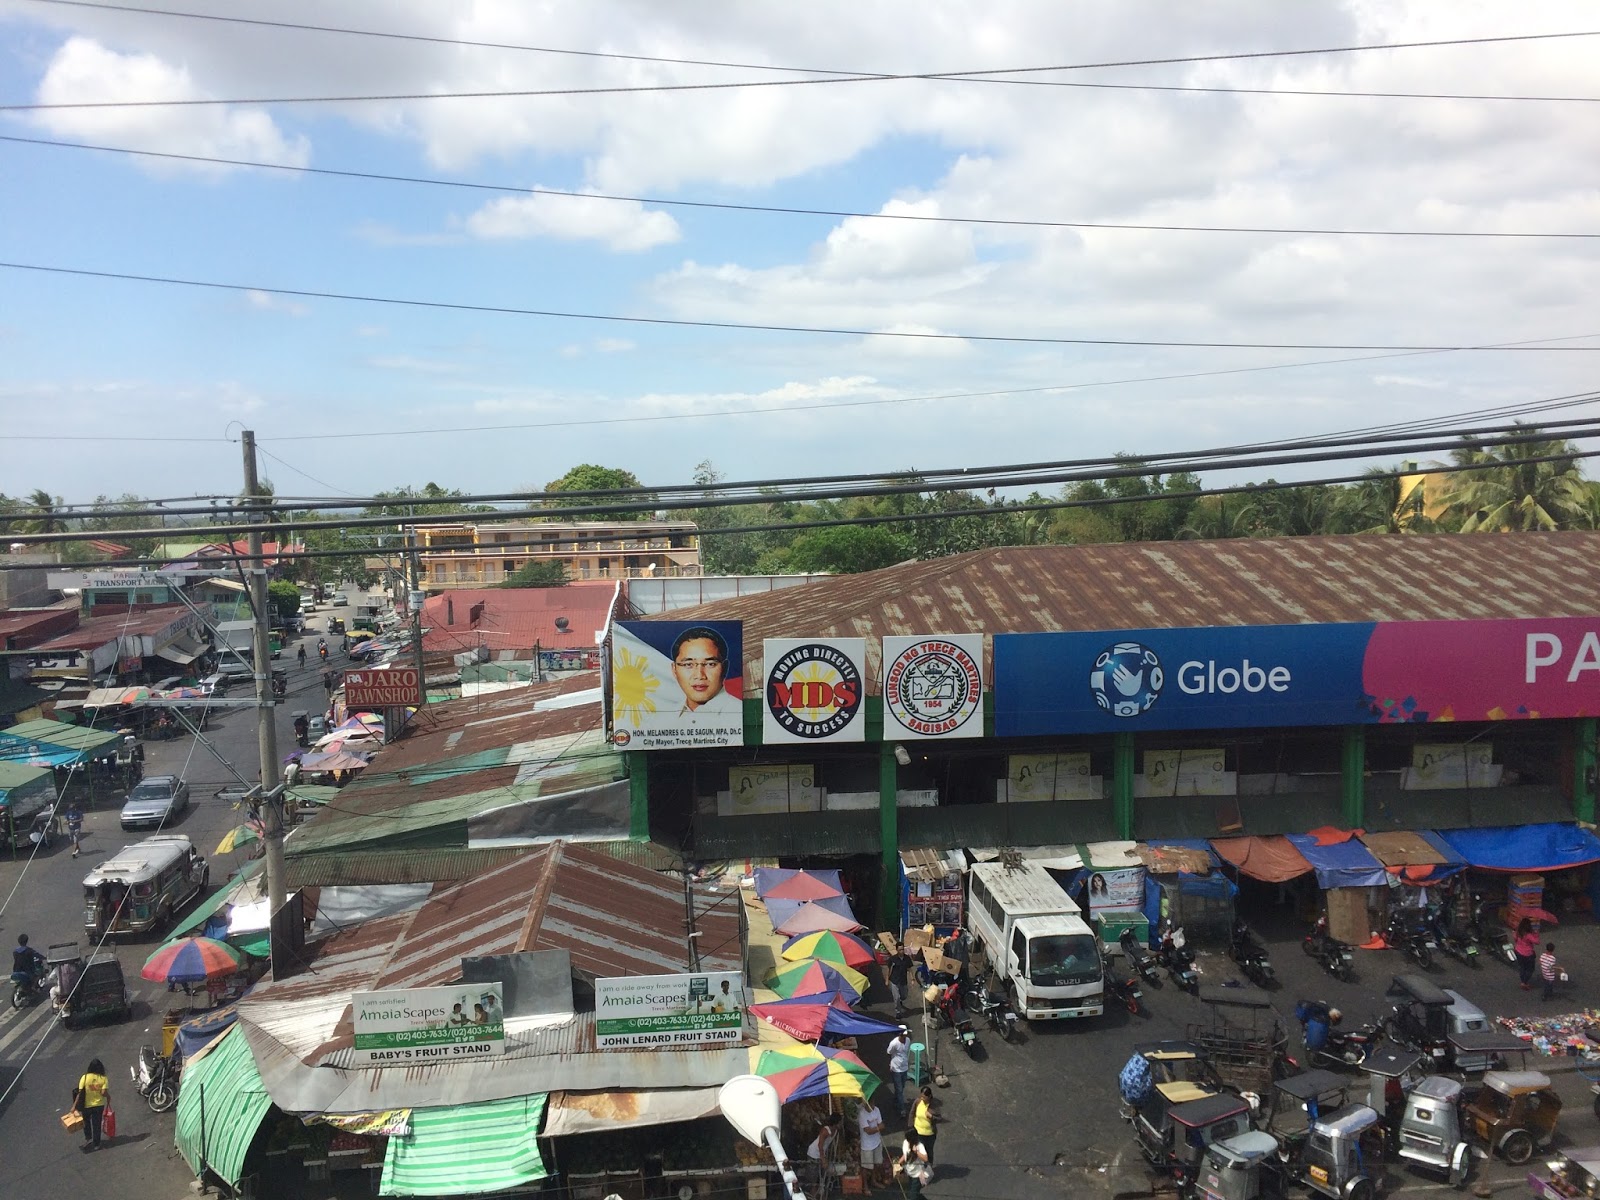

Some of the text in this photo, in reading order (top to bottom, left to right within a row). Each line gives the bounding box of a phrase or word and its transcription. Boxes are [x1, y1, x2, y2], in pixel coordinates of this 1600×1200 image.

[94, 578, 142, 587] TRANSPORT
[773, 647, 857, 680] MOVING DIRECTLY
[1526, 631, 1600, 683] PA
[363, 671, 417, 687] JARO
[888, 643, 979, 705] LUNSOD NG TRECE MARTIRES
[1177, 659, 1291, 694] Globe
[348, 687, 418, 704] PAWNSHOP
[772, 681, 857, 708] MDS
[924, 700, 942, 708] 1954
[779, 710, 850, 735] TO SUCCESS
[907, 718, 958, 733] SAGISAG
[647, 729, 679, 737] MELANDRES
[643, 738, 655, 747] City
[655, 738, 675, 746] Mayor,
[636, 984, 654, 992] away
[1055, 978, 1081, 986] ISUZU
[379, 997, 406, 1005] satisfied
[602, 993, 686, 1006] Amaia Scapes
[359, 1007, 445, 1021] Amaia Scapes
[602, 1030, 737, 1046] JOHN LENARD FRUIT STAND
[370, 1044, 492, 1060] BABY'S FRUIT STAND
